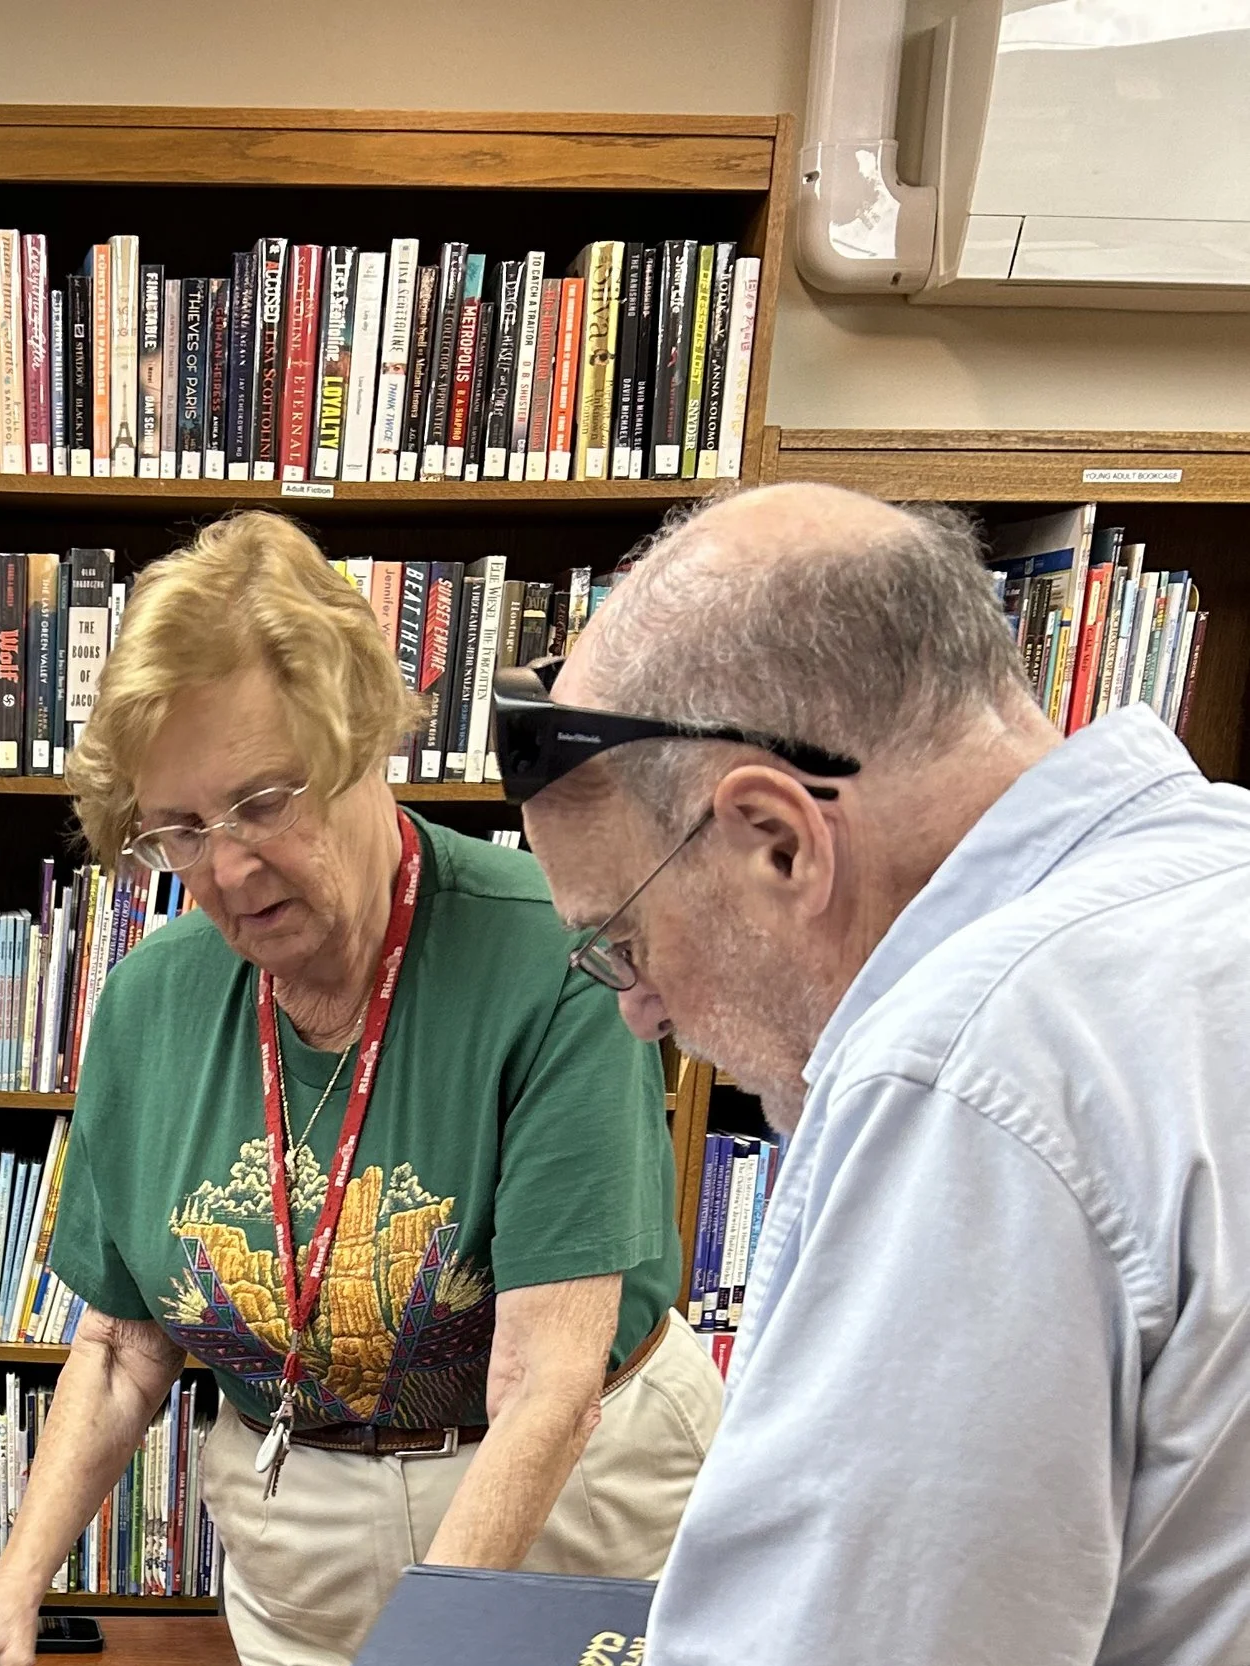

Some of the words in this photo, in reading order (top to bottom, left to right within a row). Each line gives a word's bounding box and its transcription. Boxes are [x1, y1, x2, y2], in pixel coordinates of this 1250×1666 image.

[532, 256, 541, 266] TO
[529, 270, 539, 298] CATCH
[187, 292, 201, 351] THIEVES
[525, 310, 537, 346] TRAITOR
[454, 306, 476, 382] METROPOLIS
[186, 354, 197, 372] OF
[186, 377, 198, 419] PARIS
[387, 382, 398, 410] THINK
[290, 376, 305, 460] ETERNAL
[321, 376, 343, 449] LOYALTY
[384, 413, 395, 442] TWICE
[306, 487, 331, 495] Fiction
[41, 579, 49, 594] THE
[382, 569, 395, 617] Jennifer
[40, 598, 49, 618] LAST
[436, 578, 453, 626] SUNSET
[40, 621, 49, 651] GREEN
[78, 621, 95, 634] THE
[430, 627, 448, 673] EMPIRE
[1081, 654, 1090, 672] Meir
[39, 654, 48, 683] VALLEY
[80, 670, 91, 682] OF
